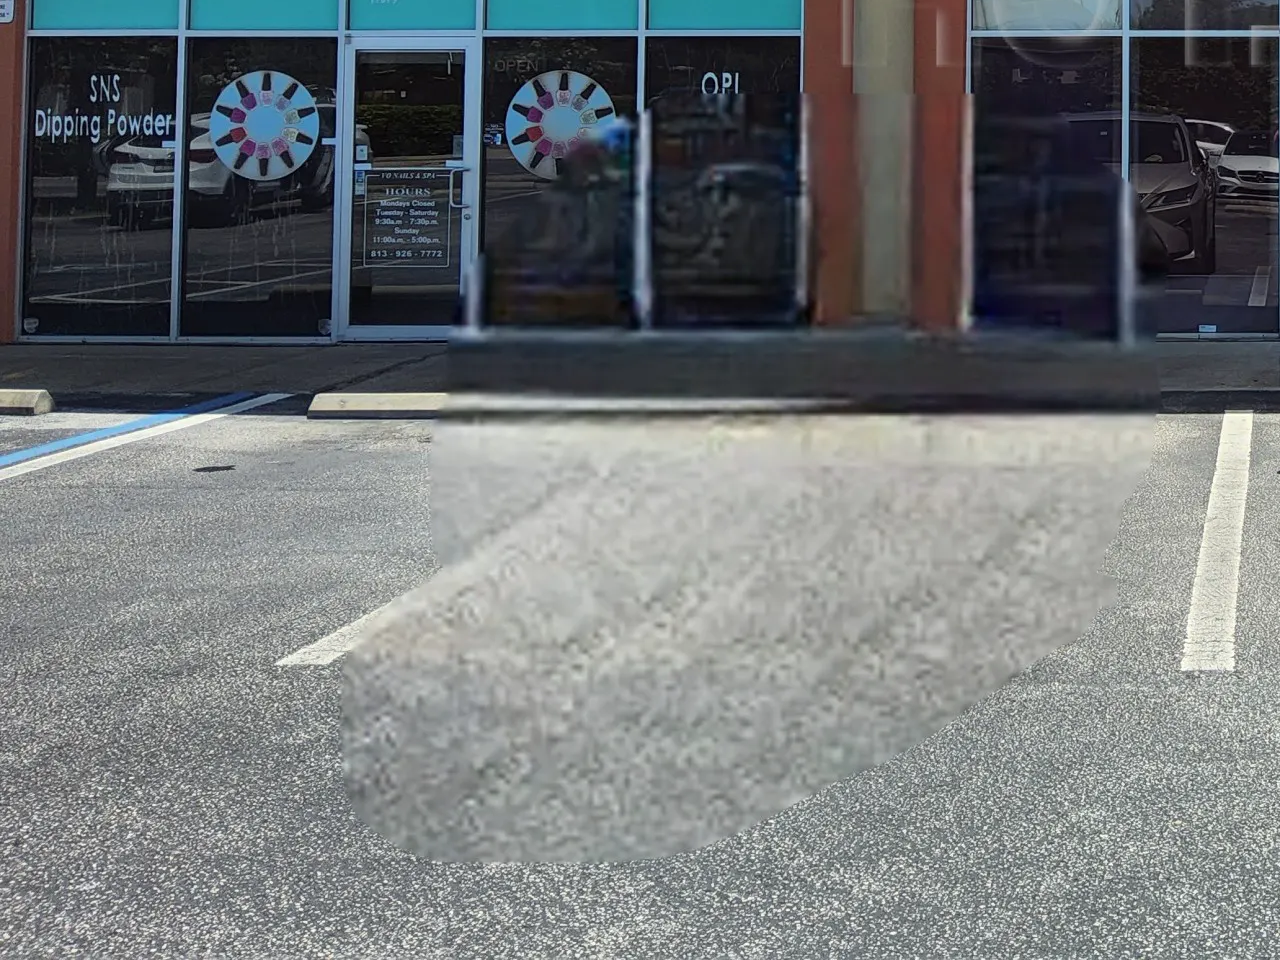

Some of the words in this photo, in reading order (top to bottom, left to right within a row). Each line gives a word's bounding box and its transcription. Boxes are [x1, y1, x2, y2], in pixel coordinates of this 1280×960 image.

[494, 58, 539, 73] OPEN
[90, 74, 121, 103] SNS
[34, 108, 101, 144] Dipping
[107, 107, 173, 136] Powder
[386, 188, 431, 196] HOURS
[380, 200, 410, 208] Mondays
[376, 209, 403, 217] Tuesday
[409, 209, 439, 217] Saturday
[394, 227, 420, 235] Sunday
